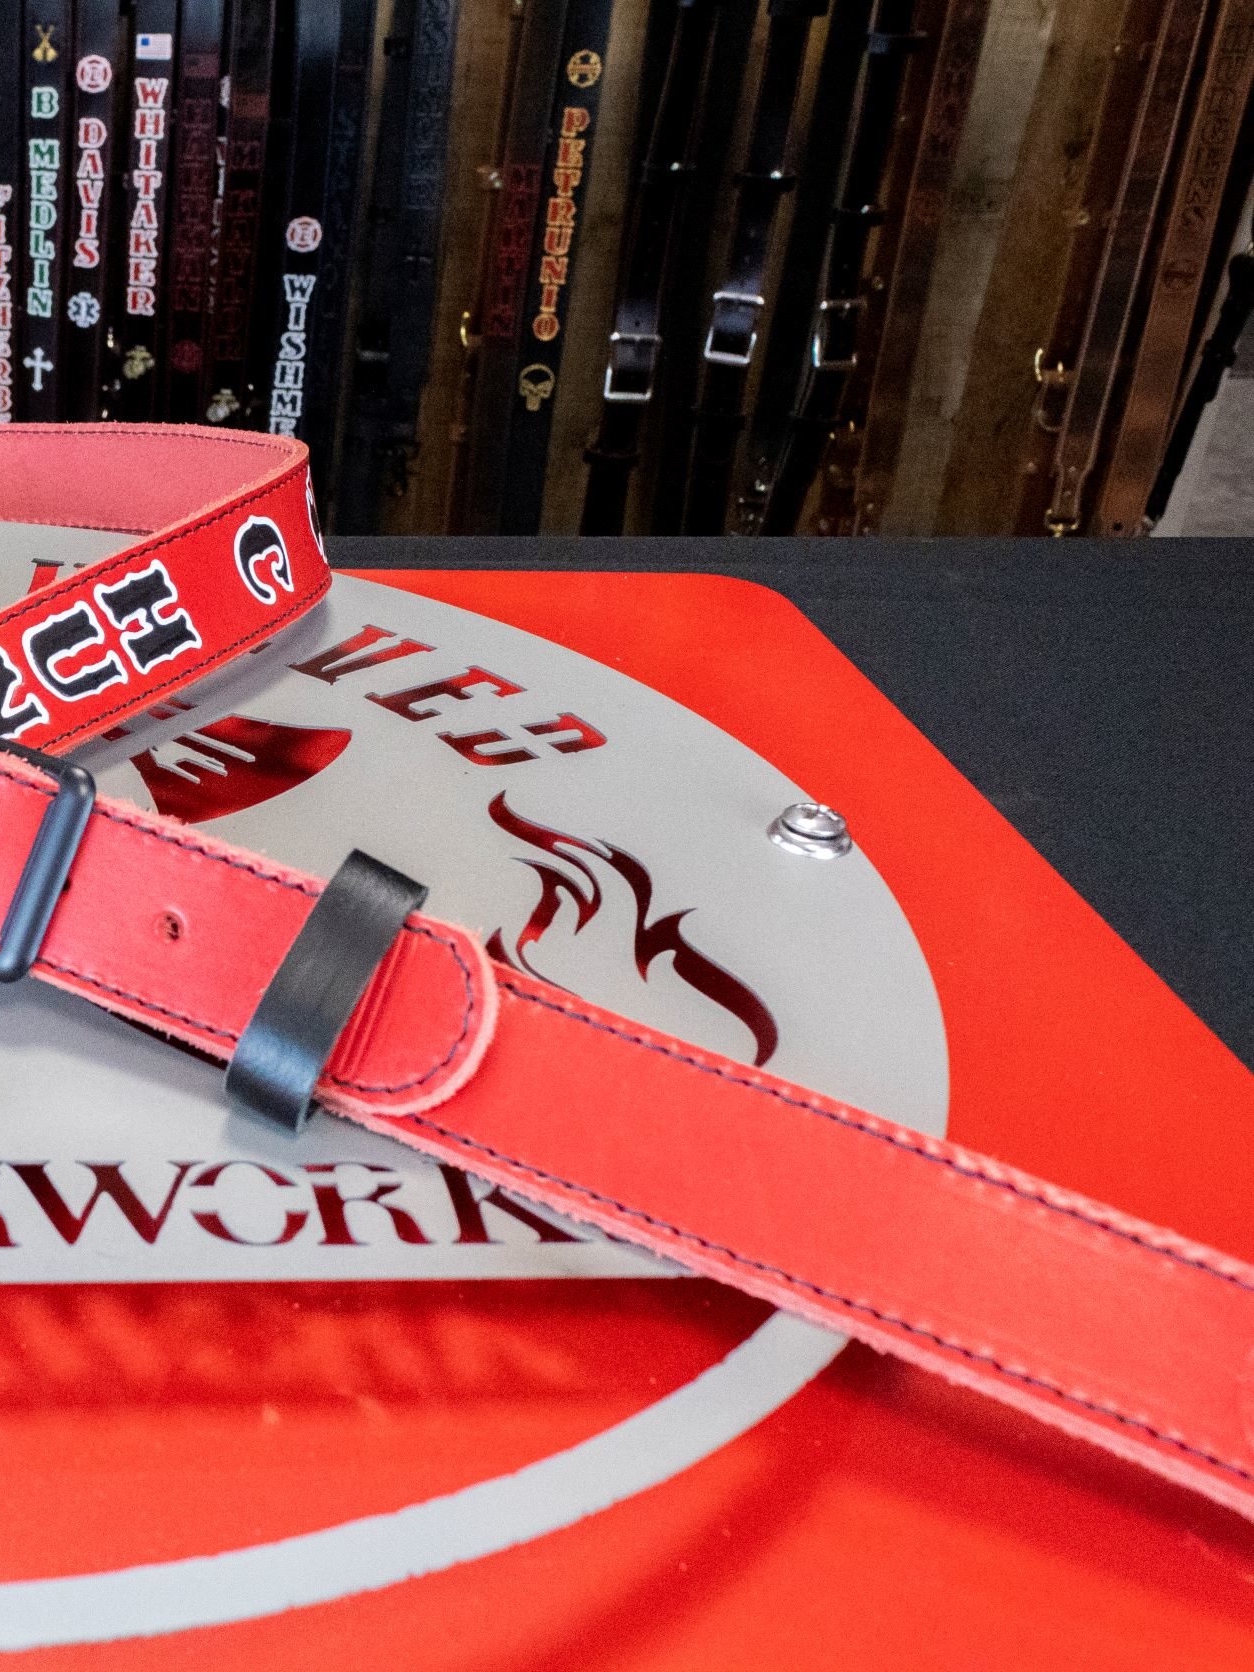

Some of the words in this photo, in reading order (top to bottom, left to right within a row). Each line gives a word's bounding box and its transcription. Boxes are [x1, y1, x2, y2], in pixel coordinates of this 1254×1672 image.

[31, 87, 59, 118] B
[27, 139, 60, 317] MEDLIN
[74, 118, 106, 268] DAVIS
[127, 77, 168, 316] WHITAKER
[532, 106, 591, 341] PETRUNIO
